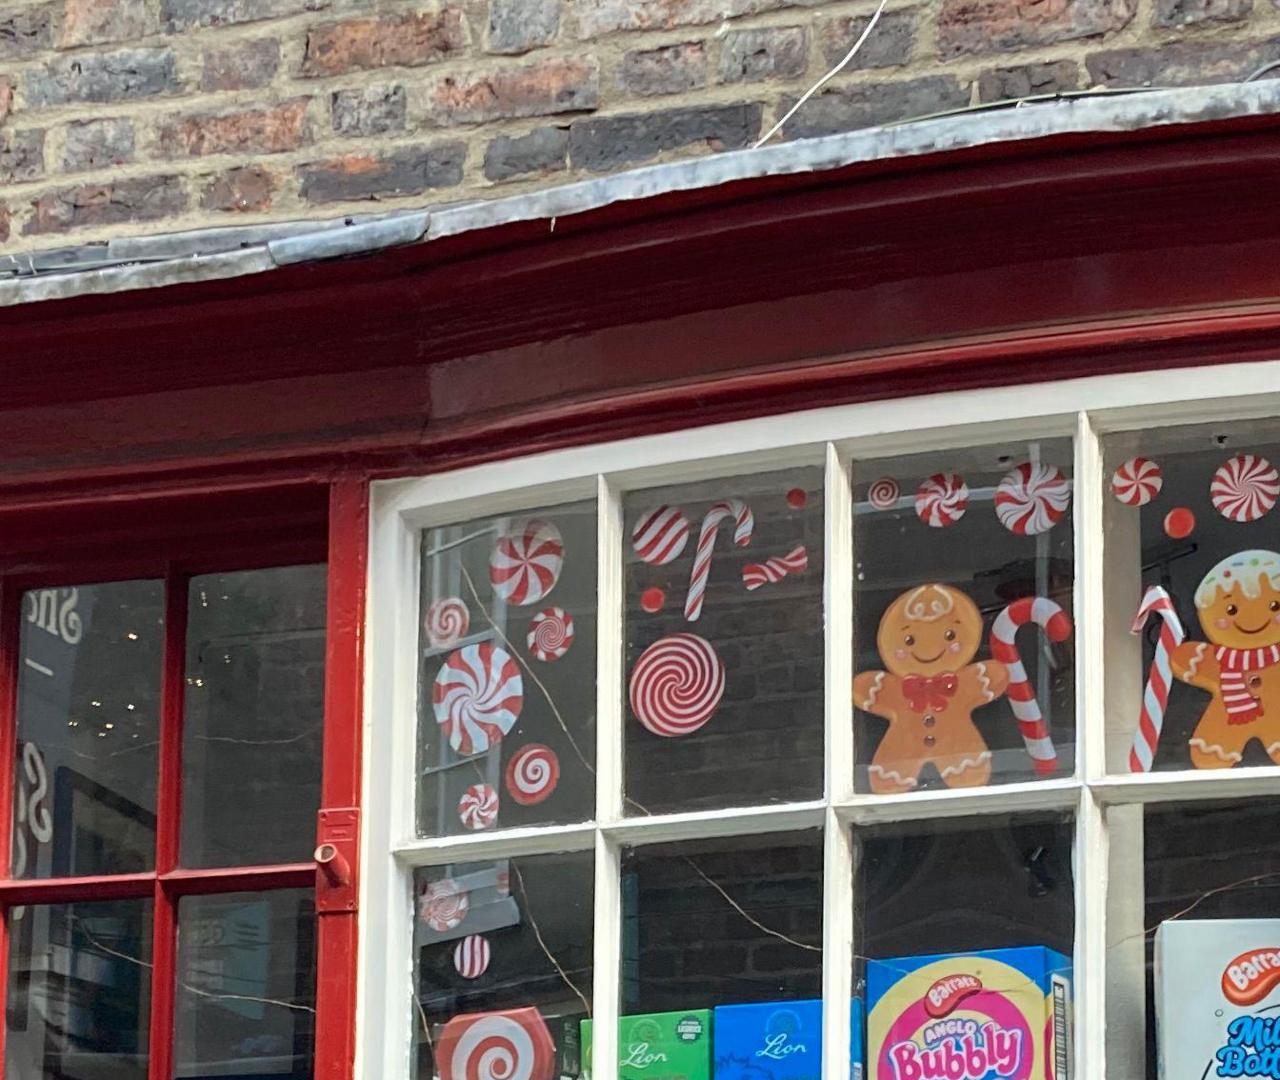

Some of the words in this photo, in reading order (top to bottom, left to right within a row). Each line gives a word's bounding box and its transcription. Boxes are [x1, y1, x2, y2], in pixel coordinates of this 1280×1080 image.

[928, 975, 979, 1007] Barratt
[925, 1018, 979, 1045] ANGLO
[620, 1042, 667, 1069] Lion
[756, 1033, 807, 1060] Lion
